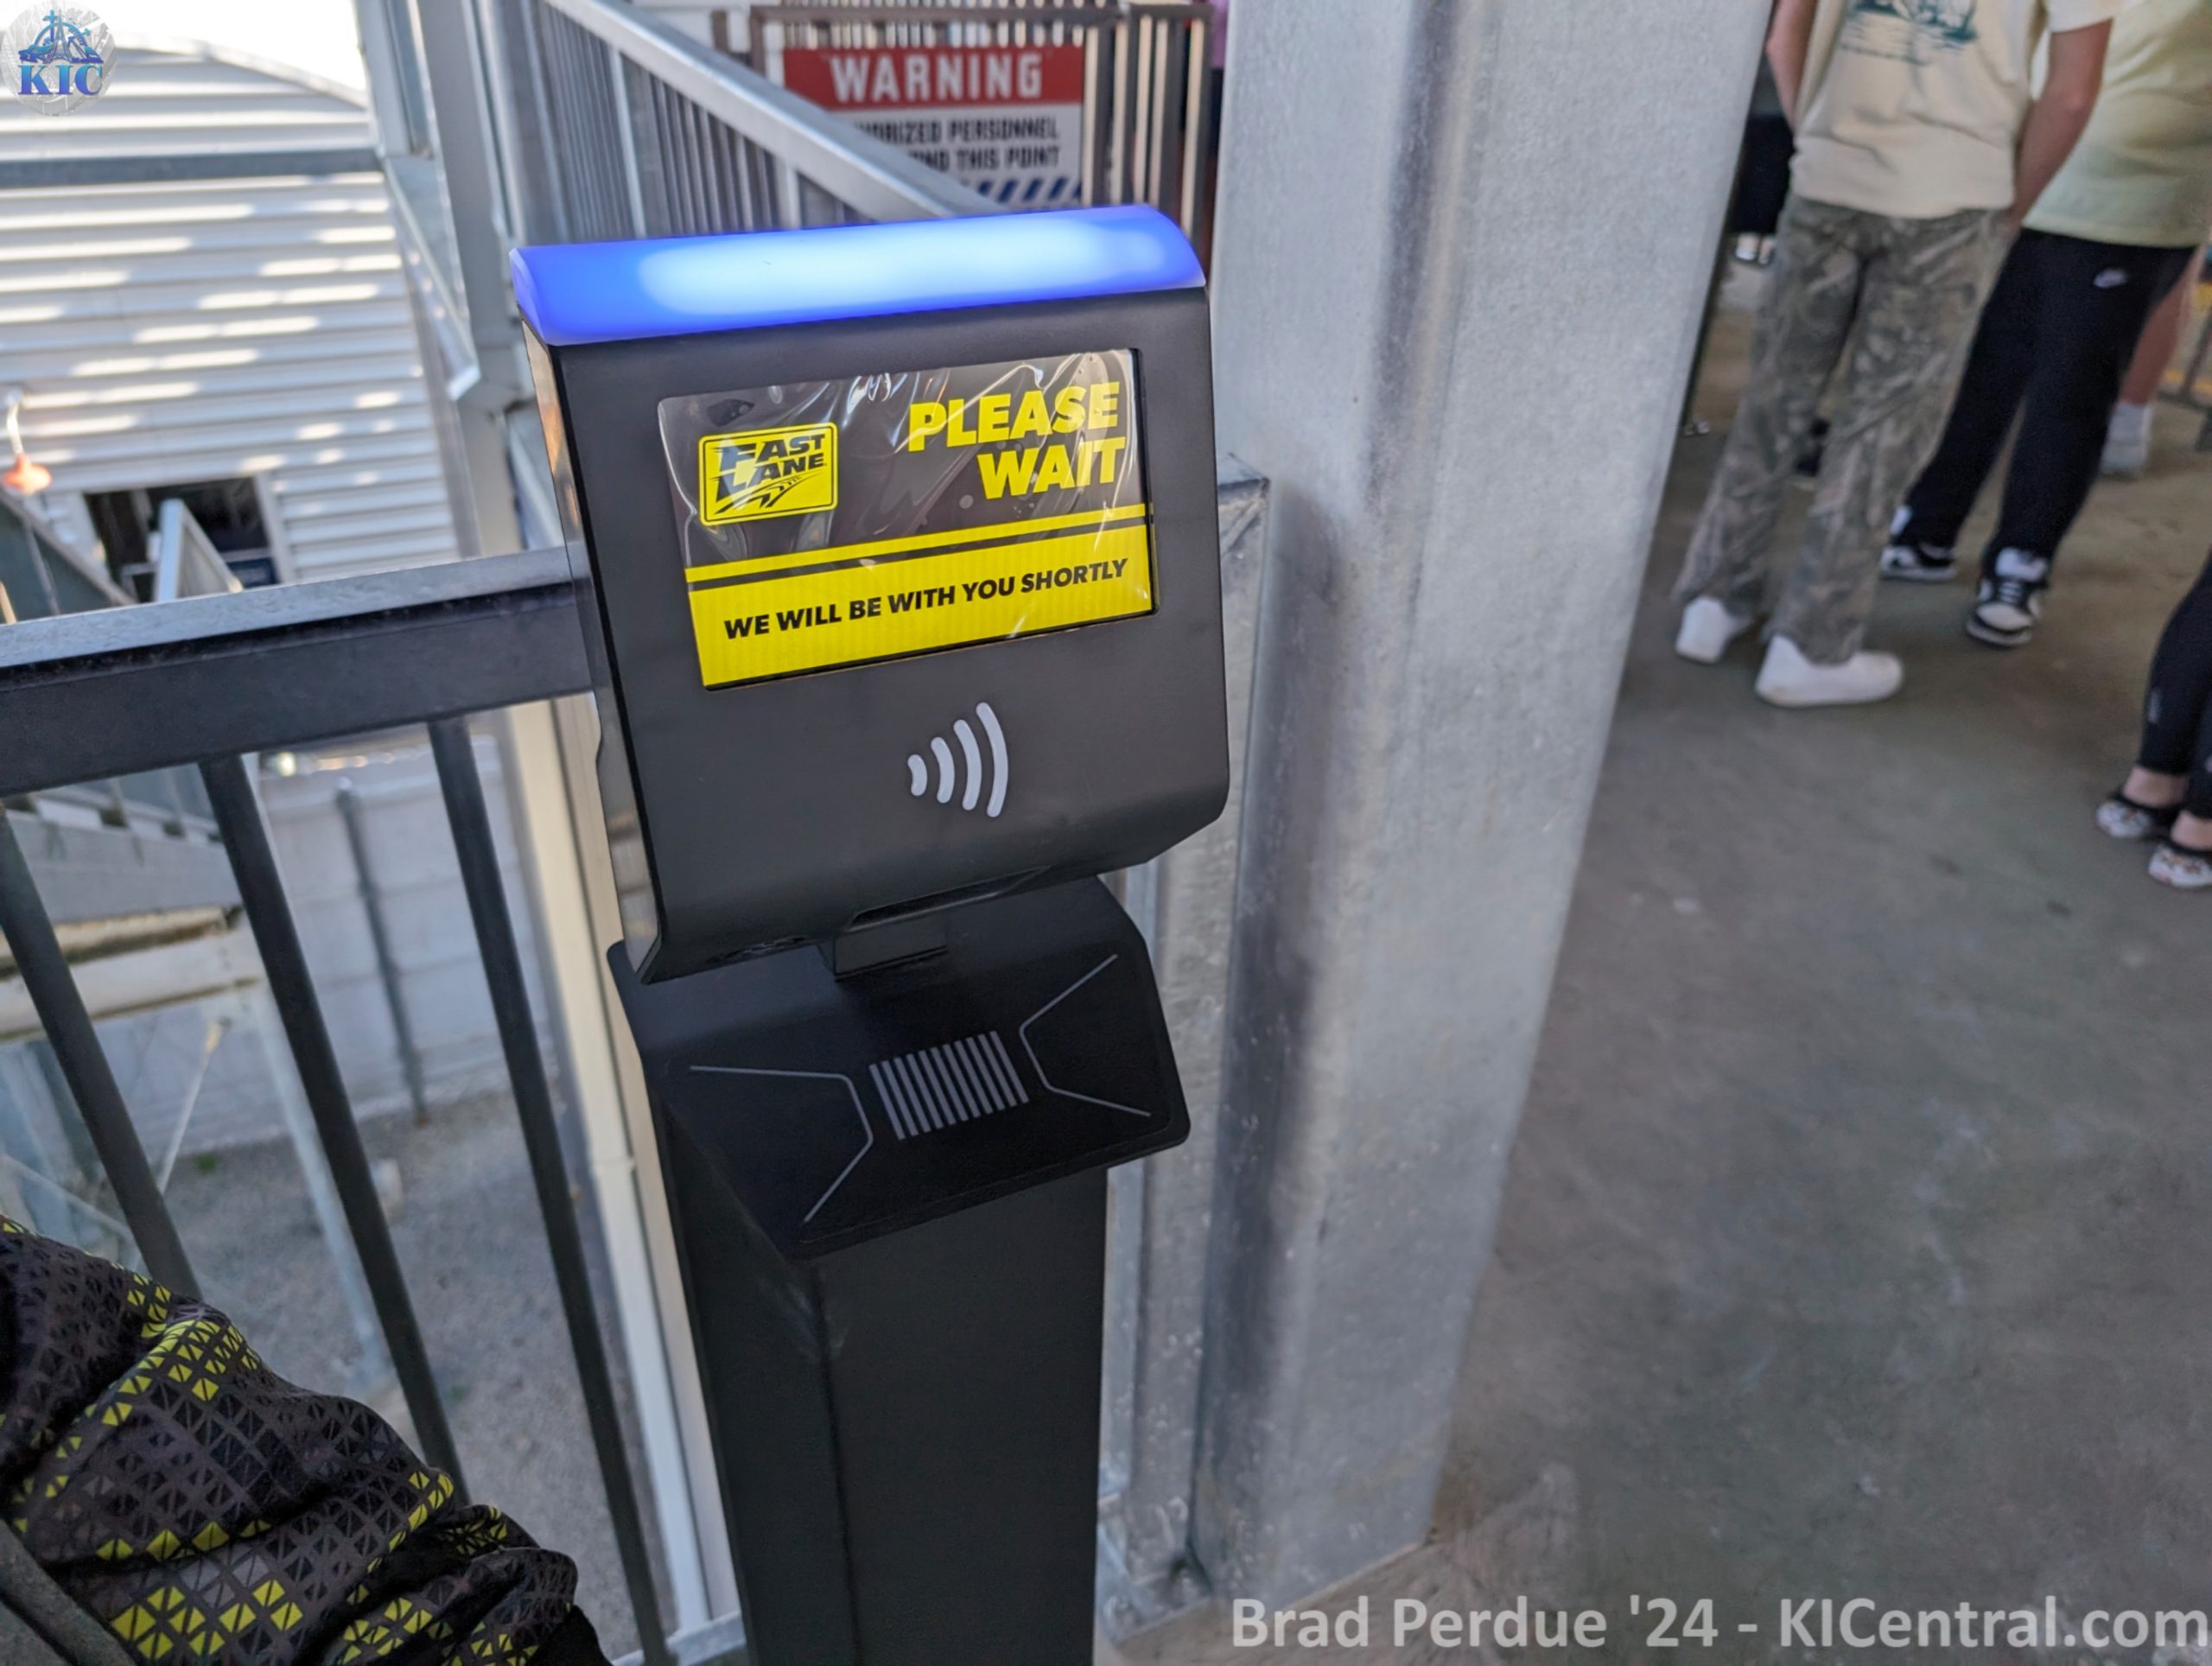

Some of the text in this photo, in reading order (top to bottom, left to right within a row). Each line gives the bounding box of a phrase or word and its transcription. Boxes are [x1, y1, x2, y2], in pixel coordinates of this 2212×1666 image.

[830, 54, 1042, 101] WARNING
[950, 117, 1059, 143] PERSONNEL
[957, 149, 999, 170] THIS
[1005, 146, 1060, 169] POINT
[908, 382, 1119, 451] PLEASE
[710, 434, 825, 472] FAST
[977, 436, 1125, 499] WAIT
[709, 453, 824, 502] LANE
[724, 558, 1128, 639] WE WILL BE WITH YOU SHORTLY
